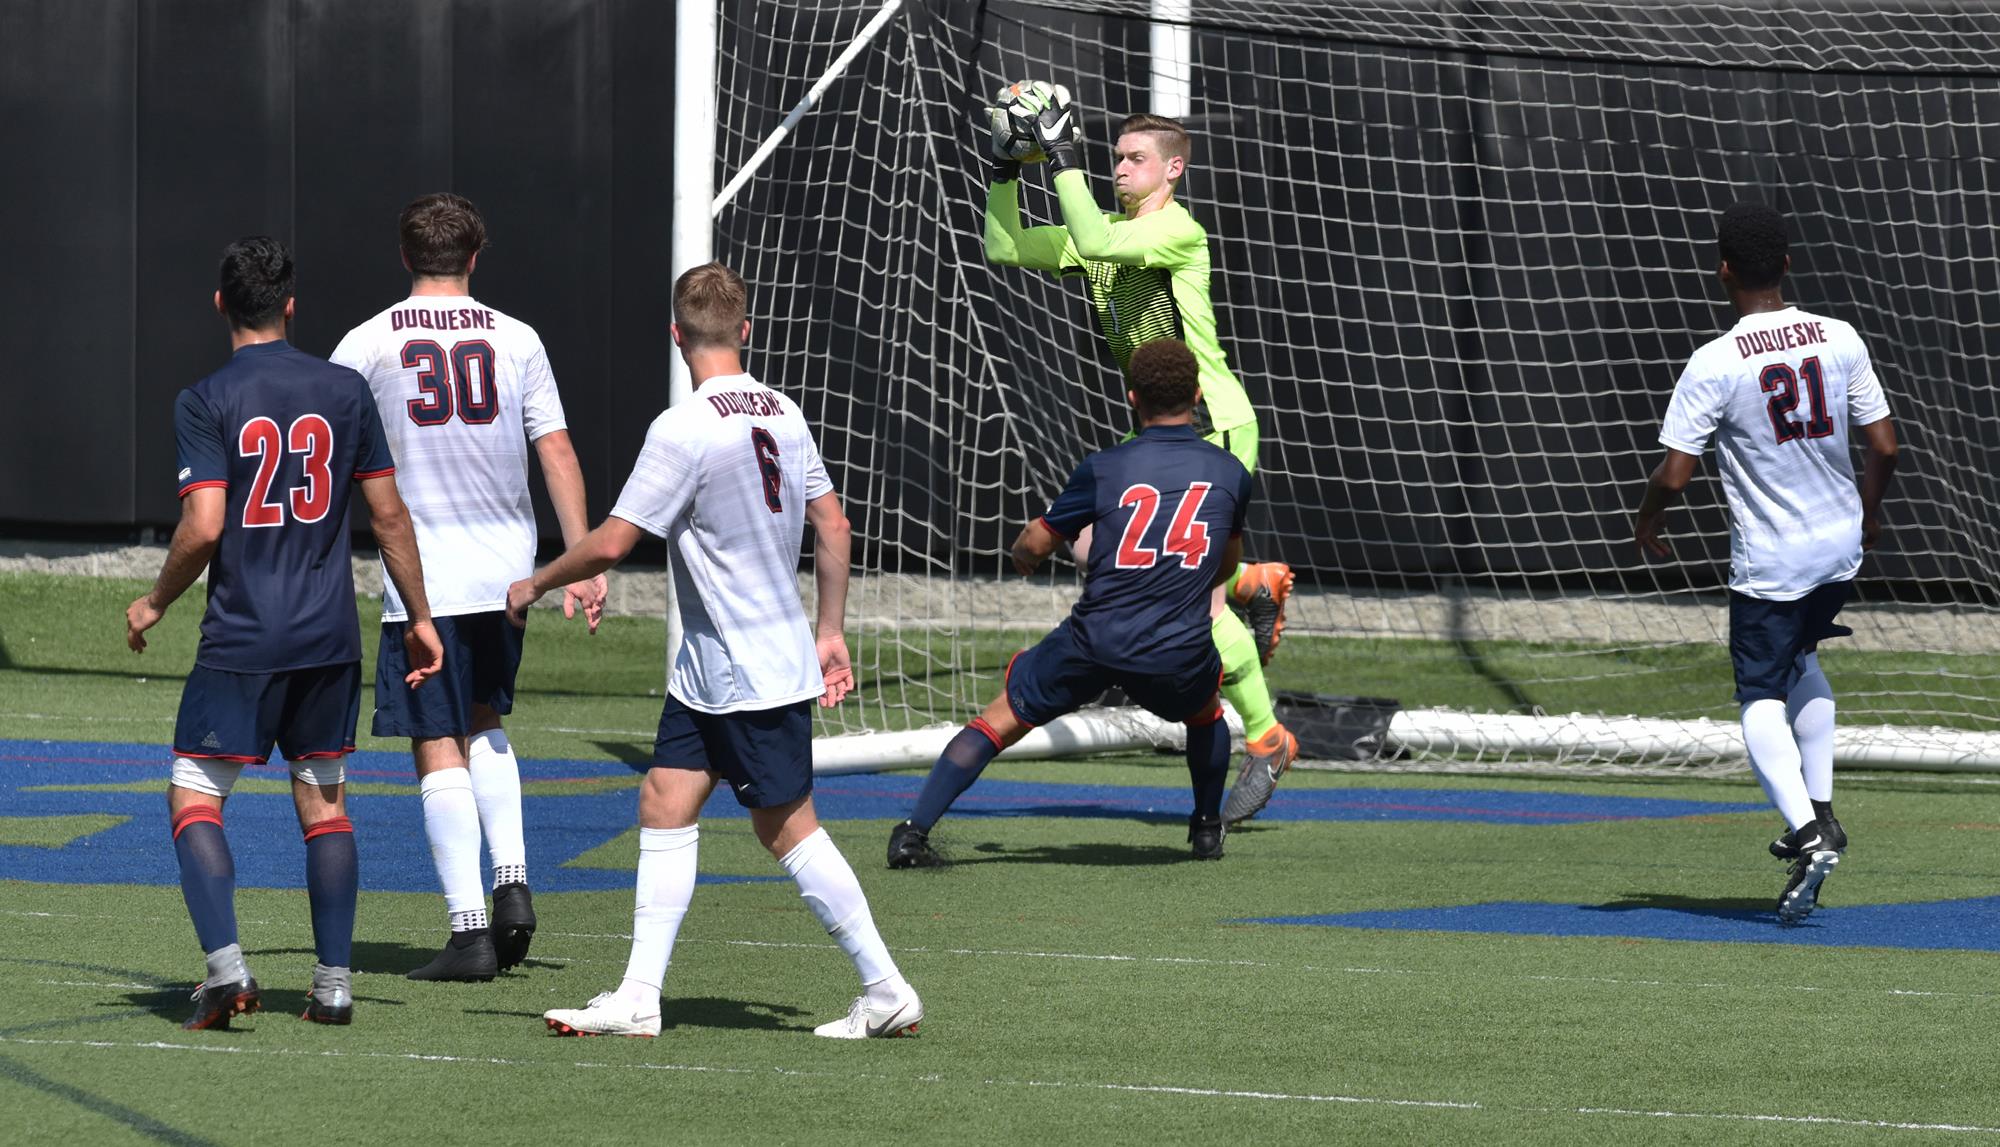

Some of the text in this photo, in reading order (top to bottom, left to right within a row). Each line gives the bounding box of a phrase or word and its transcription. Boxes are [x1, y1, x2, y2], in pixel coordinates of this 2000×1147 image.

[391, 309, 495, 331] DUQUESNE
[1735, 322, 1827, 360] DUQUESNE
[400, 339, 499, 427] 30
[1759, 355, 1834, 446] 21
[239, 413, 334, 528] 23
[751, 427, 783, 513] 6
[1115, 481, 1212, 569] 24
